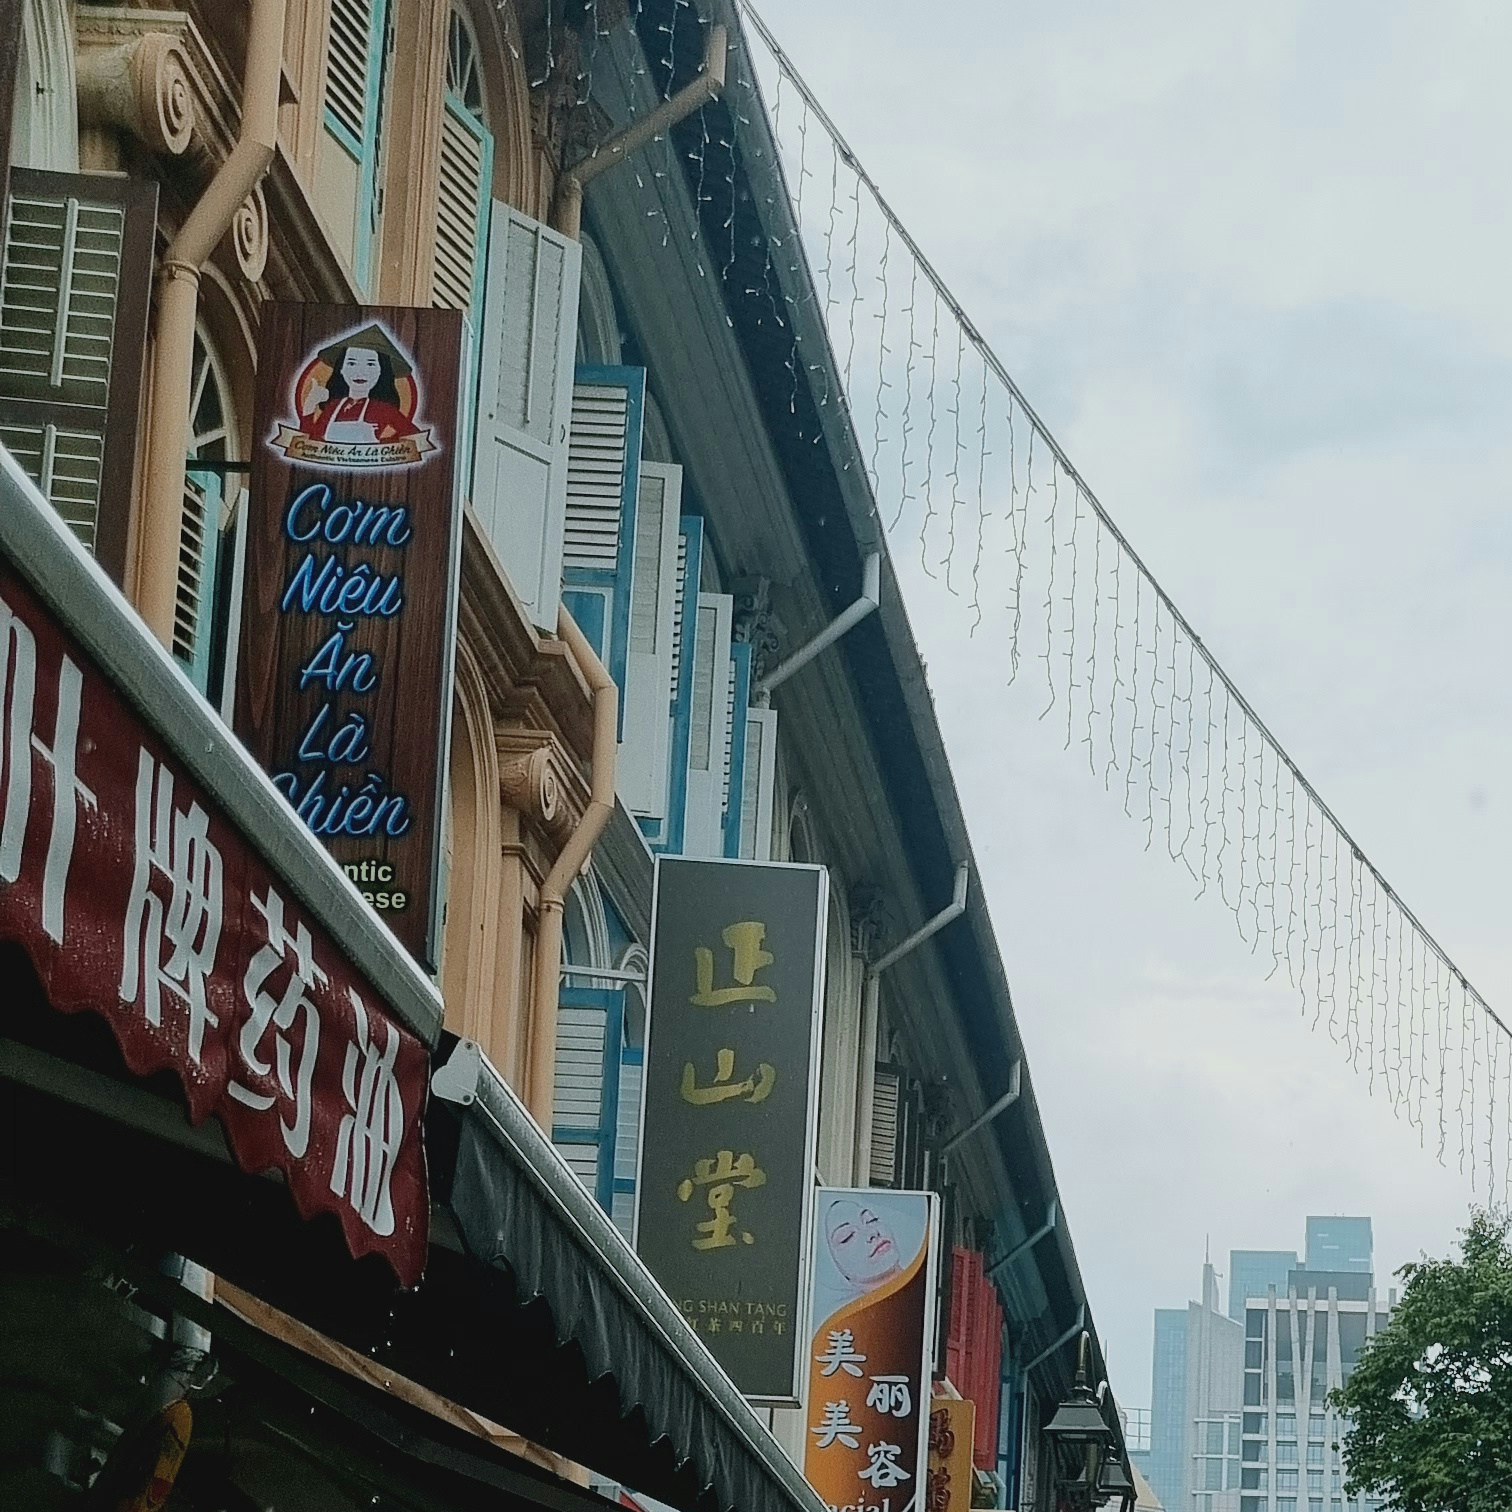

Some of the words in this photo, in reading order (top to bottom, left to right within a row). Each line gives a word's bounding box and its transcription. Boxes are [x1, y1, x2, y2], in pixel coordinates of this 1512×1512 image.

[287, 483, 411, 546] Cơm
[282, 553, 402, 616] Niêu
[299, 620, 377, 692] Ăn
[298, 703, 368, 763] Là
[677, 920, 778, 1251] 正山堂
[699, 1300, 740, 1314] SHAN
[744, 1302, 787, 1317] TANG
